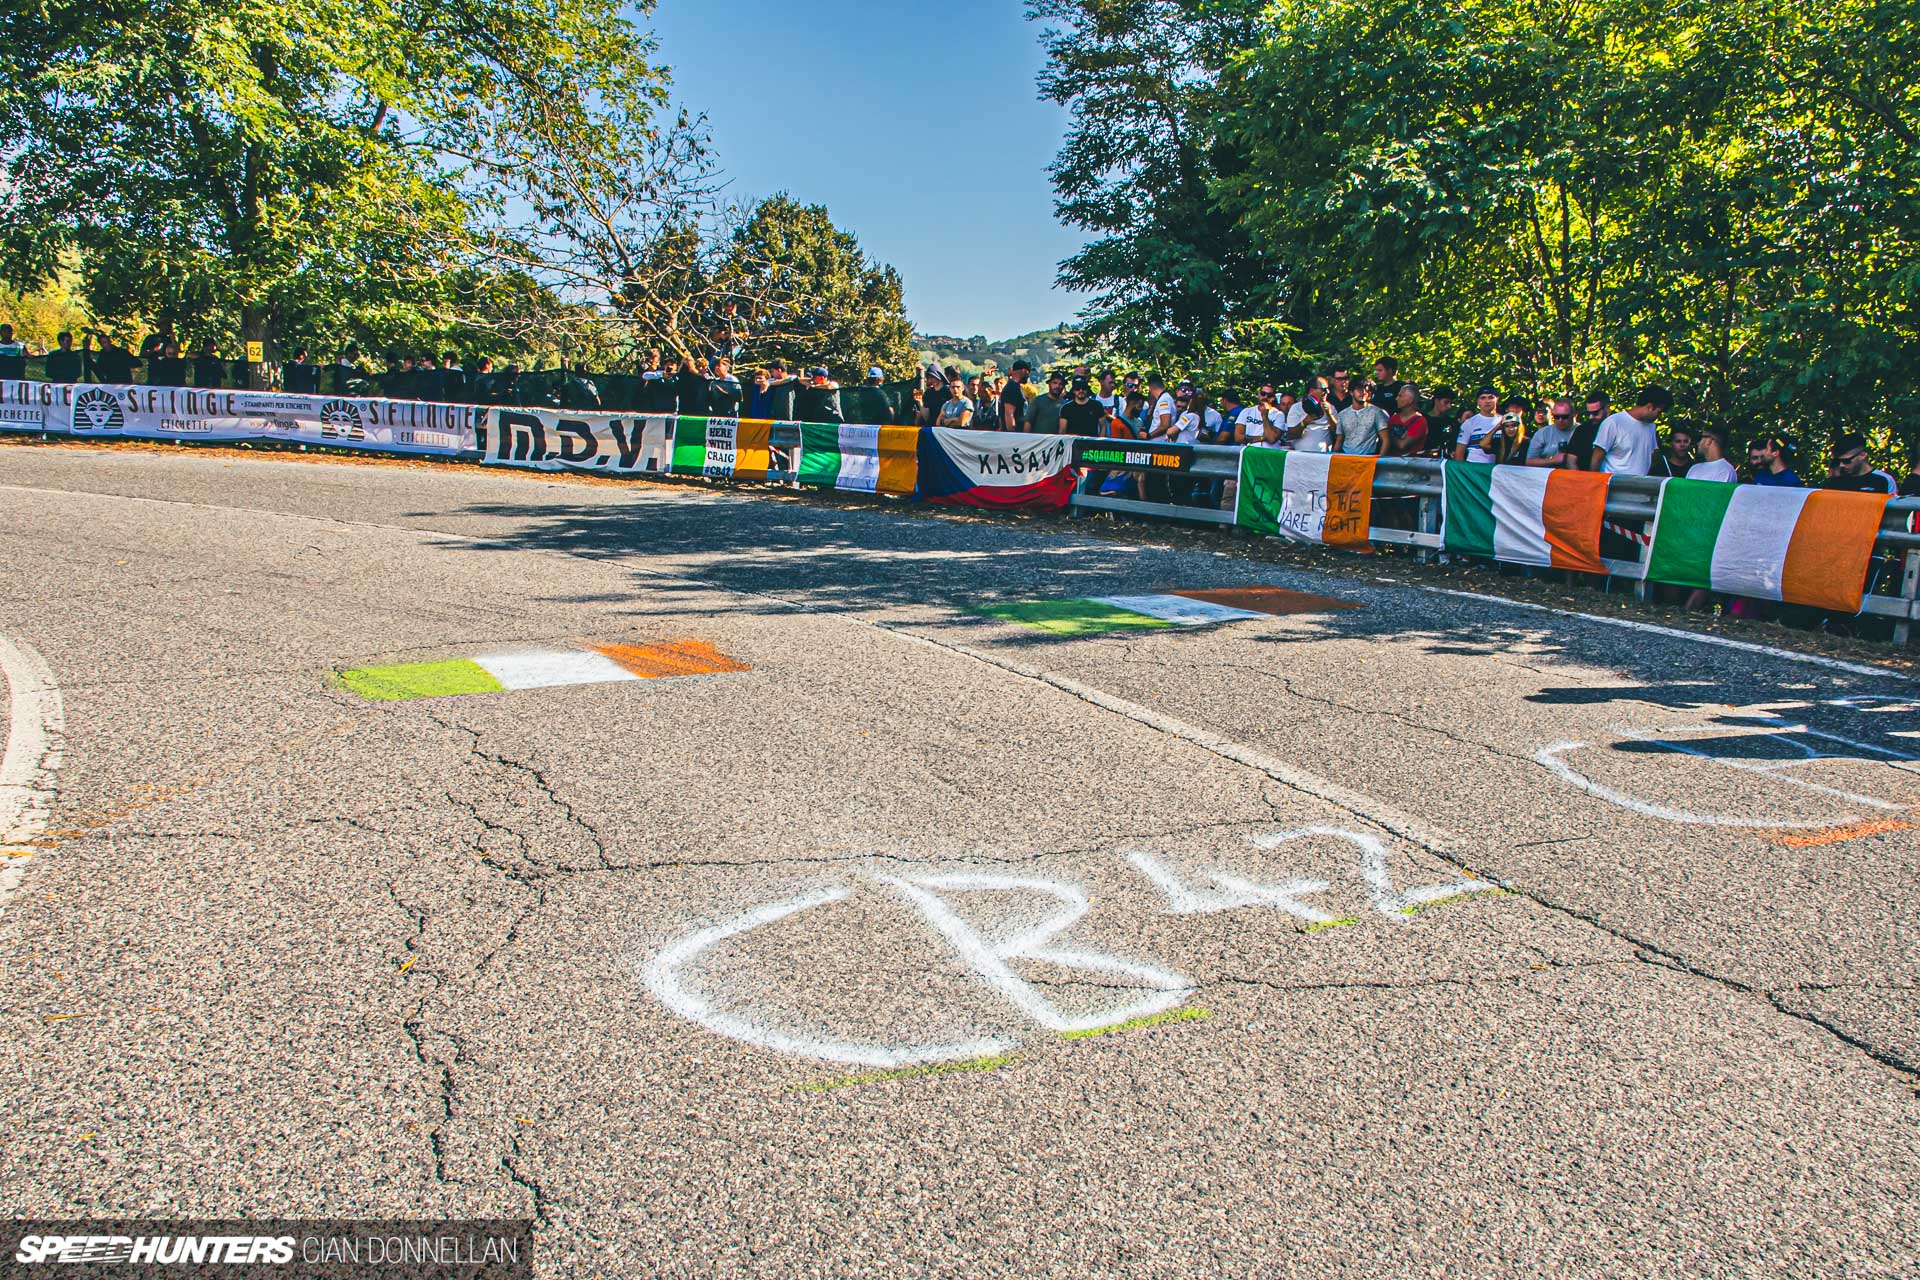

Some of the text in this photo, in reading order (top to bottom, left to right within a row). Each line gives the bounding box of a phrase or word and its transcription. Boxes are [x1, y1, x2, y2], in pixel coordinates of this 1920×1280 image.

[249, 346, 262, 356] 62
[127, 389, 237, 416] SFINGE
[369, 400, 473, 429] SFINGE
[161, 419, 208, 430] ETICHETTE
[401, 432, 446, 444] ETICHETTE
[709, 428, 733, 438] HERE
[708, 440, 732, 450] WITH
[707, 451, 735, 463] CRAIG
[978, 438, 1065, 475] KAŠAVA
[1125, 452, 1151, 465] RIGHT
[1152, 454, 1181, 468] TOURS
[704, 466, 731, 477] #CB42
[1309, 489, 1332, 512] TO
[1332, 488, 1361, 512] THE
[1317, 514, 1361, 535] RIGHT
